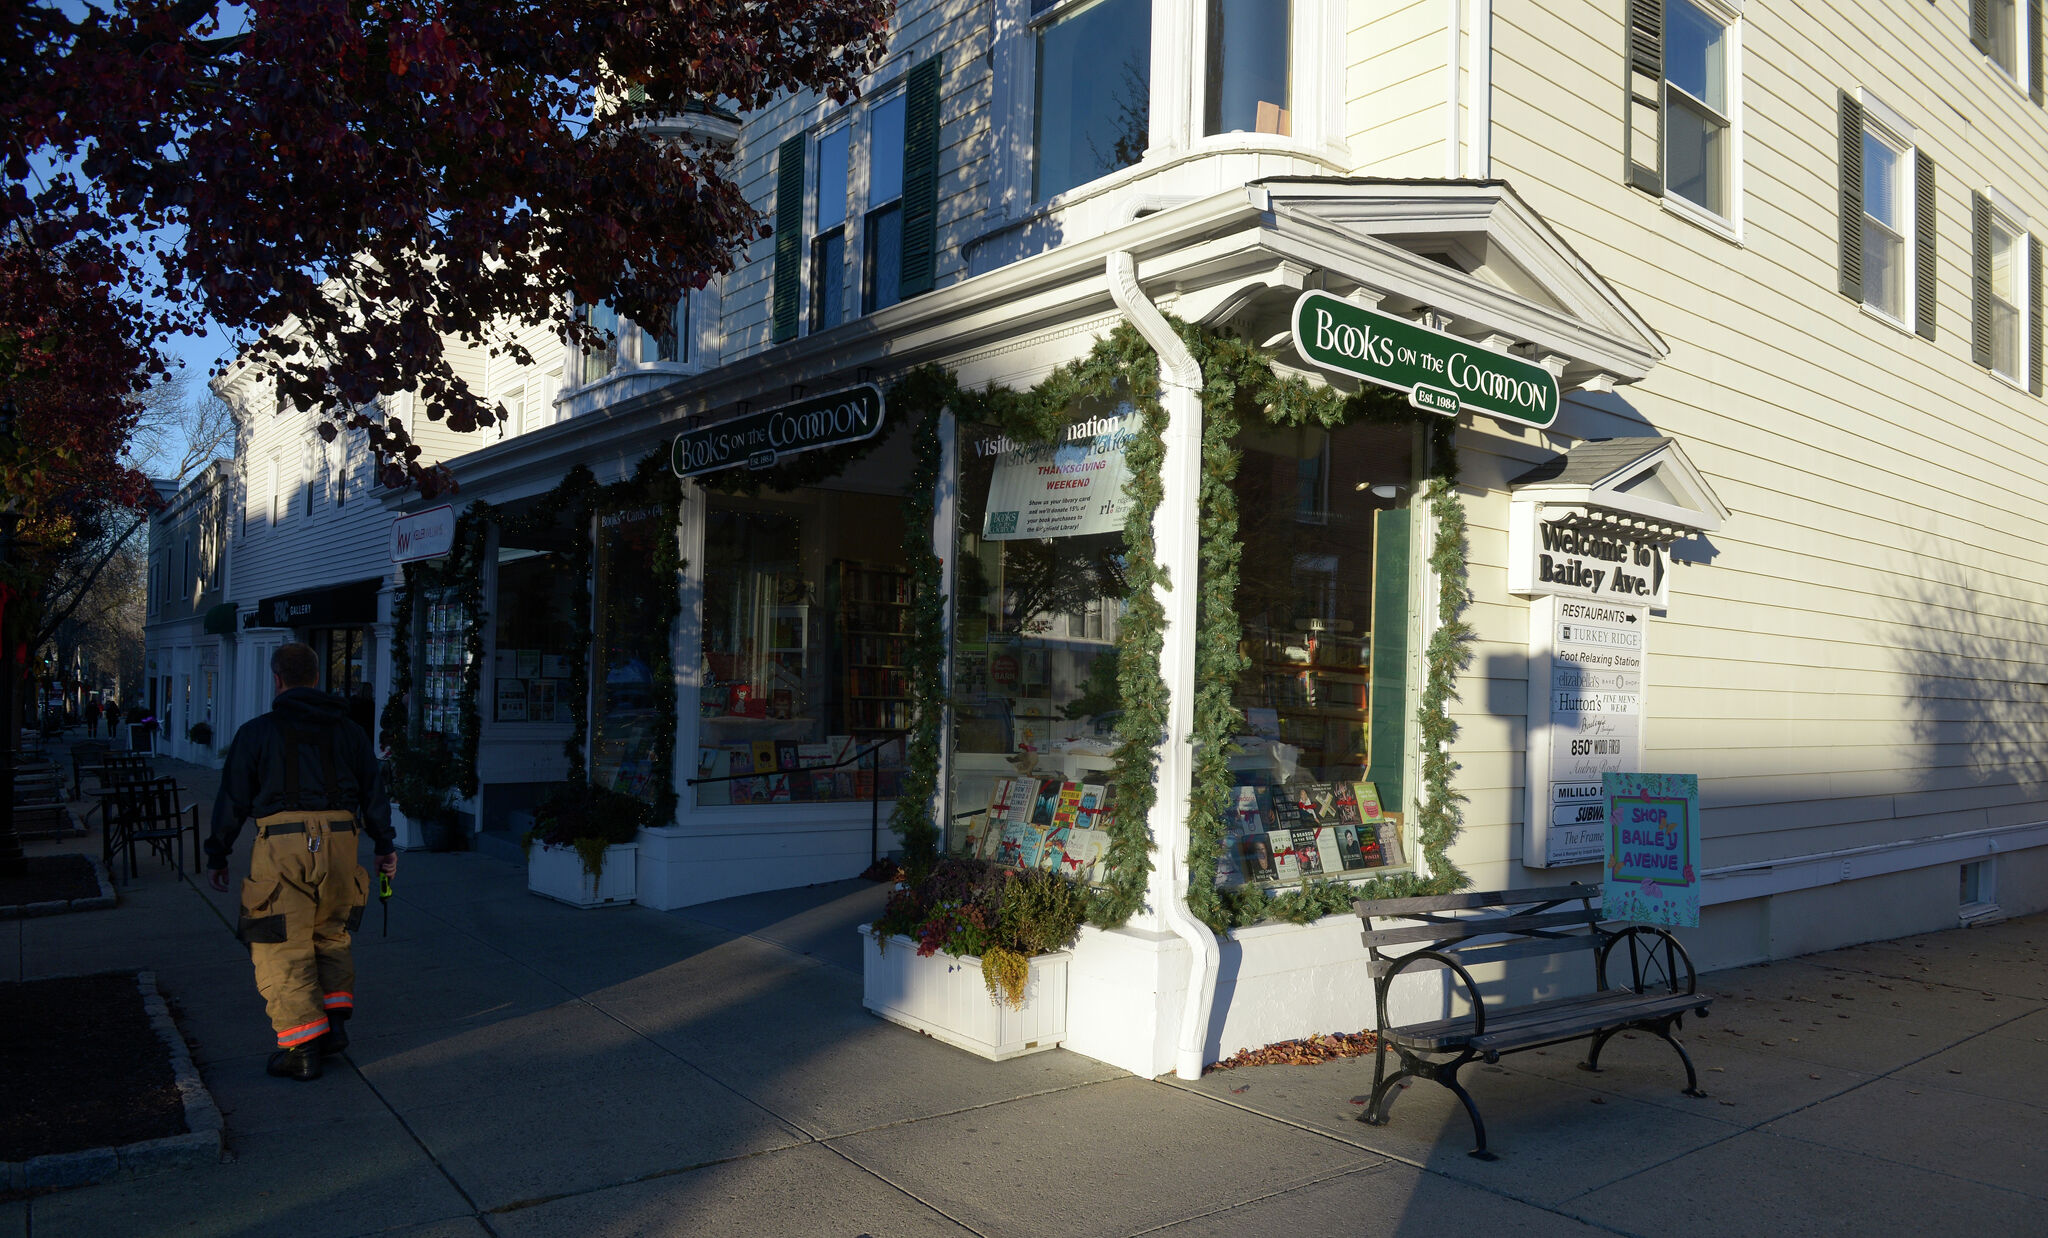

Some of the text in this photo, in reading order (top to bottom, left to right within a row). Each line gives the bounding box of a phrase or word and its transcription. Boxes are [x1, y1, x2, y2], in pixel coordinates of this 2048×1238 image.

[1418, 390, 1456, 410] Est. 1984
[974, 434, 1015, 459] Visito
[1038, 460, 1106, 476] THANKSGIVING
[1046, 478, 1090, 490] WEEKEND
[1051, 515, 1076, 523] purchases
[1540, 522, 1652, 568] Welcome to
[1538, 553, 1650, 596] Bailey Ave.
[290, 604, 312, 616] GALLERY
[1562, 604, 1624, 624] RESTAURANTS
[1574, 628, 1608, 643] TURKEY
[1611, 632, 1638, 646] RIDGE
[1560, 650, 1640, 668] Foot Relaxing Station
[1559, 693, 1602, 712] Hutton's
[1602, 694, 1636, 704] FINE MEN'S
[1610, 704, 1628, 712] WEAR
[1558, 787, 1597, 798] MILILLO
[1576, 806, 1604, 822] SUBWA
[1632, 808, 1668, 824] SHOP
[1564, 831, 1578, 845] The
[1622, 829, 1678, 850] BAILEY
[1622, 852, 1678, 870] AVENUE
